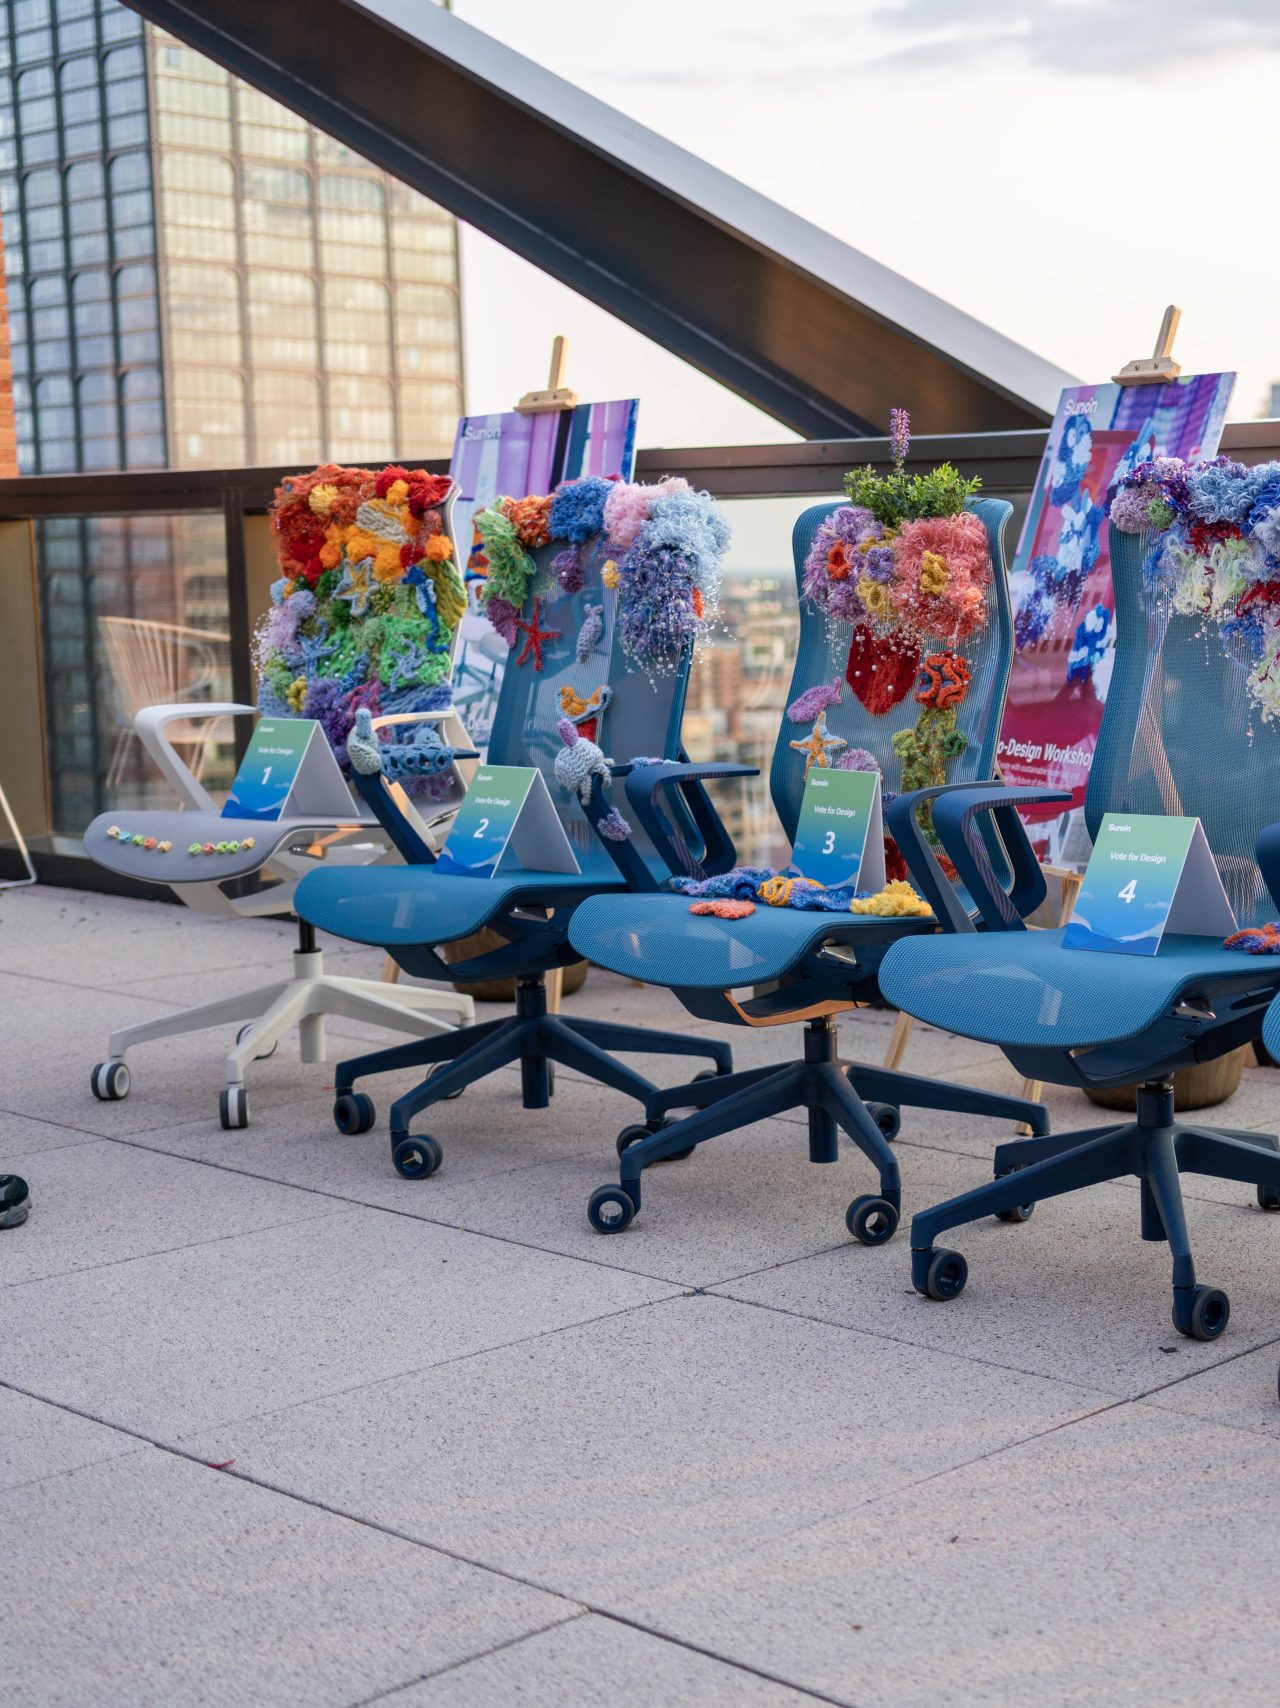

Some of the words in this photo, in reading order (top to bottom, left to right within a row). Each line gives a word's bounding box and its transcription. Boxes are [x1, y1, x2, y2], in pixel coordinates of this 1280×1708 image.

[997, 738, 1043, 764] o-Design
[261, 766, 273, 785] 1
[814, 805, 827, 814] Vote
[827, 806, 836, 815] for
[836, 807, 856, 818] Design
[473, 818, 490, 838] 2
[822, 831, 836, 855] 3
[1110, 851, 1127, 861] Vote
[1128, 852, 1139, 861] for
[1140, 853, 1167, 864] Design
[1117, 879, 1138, 904] 4
